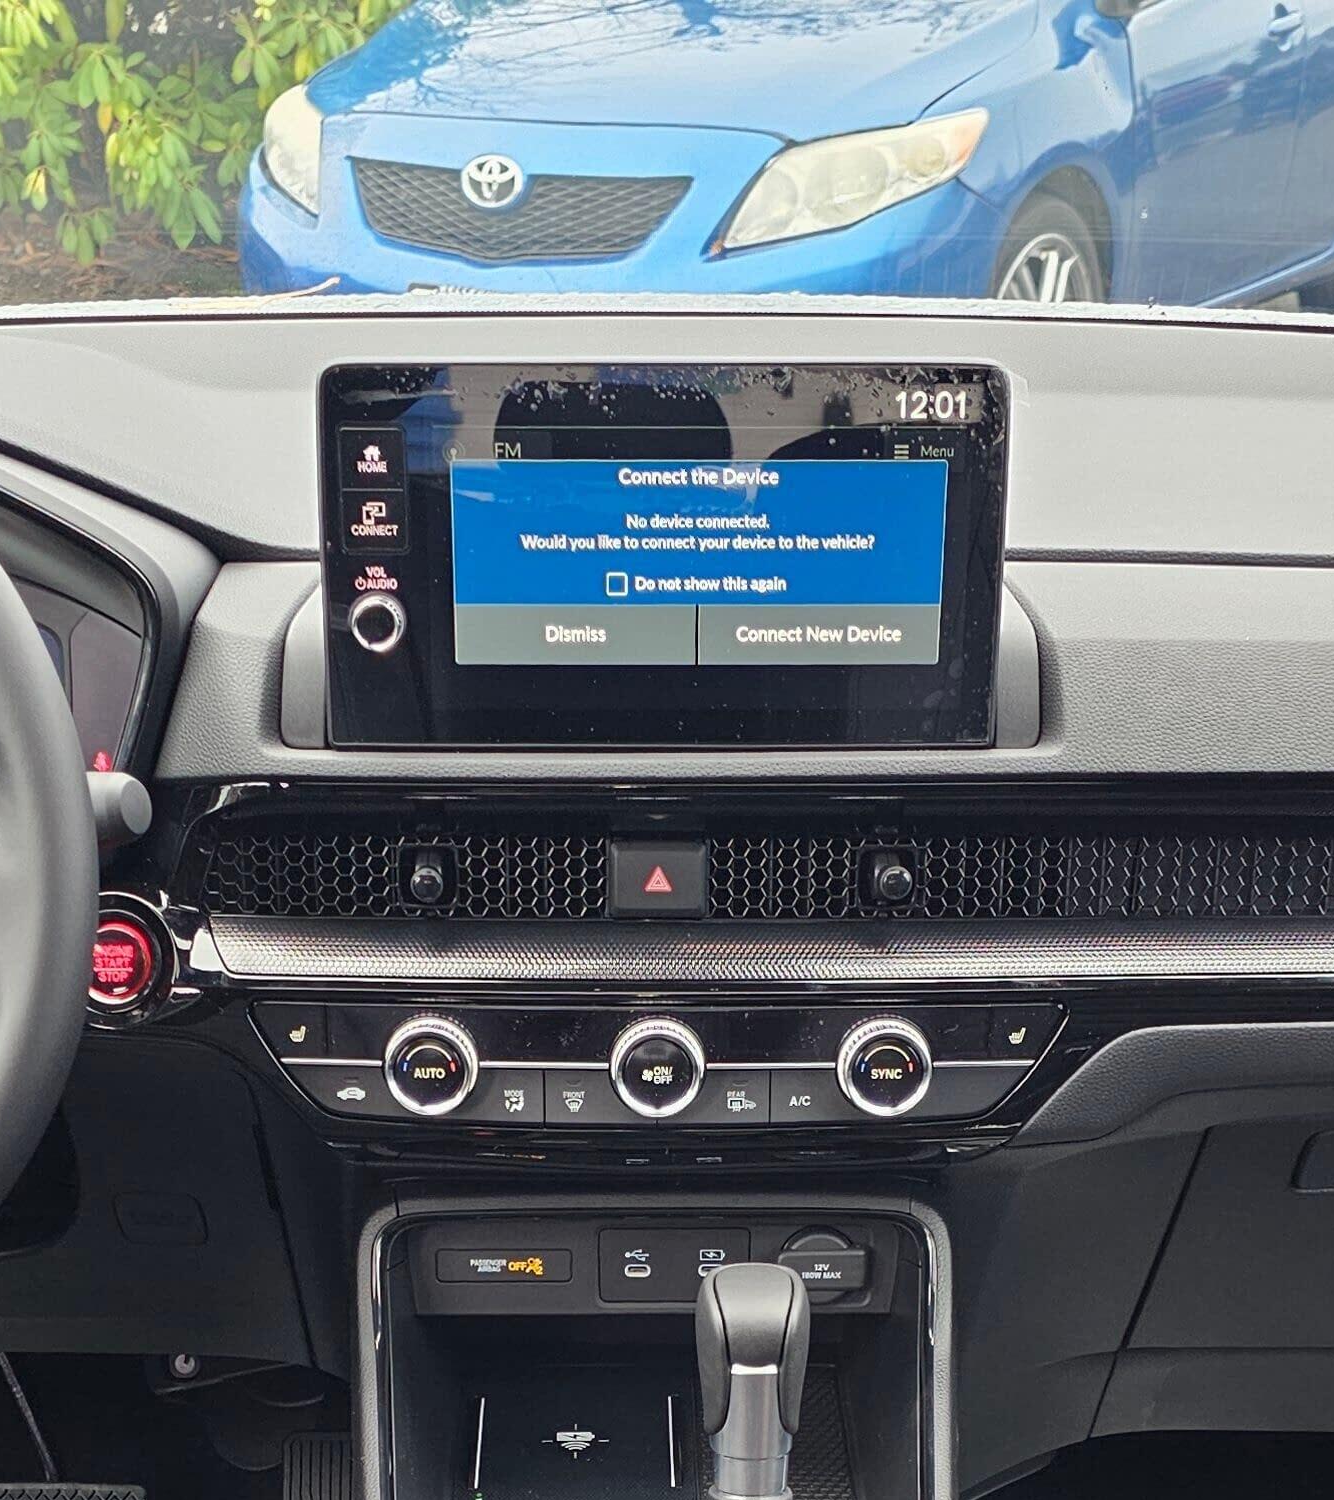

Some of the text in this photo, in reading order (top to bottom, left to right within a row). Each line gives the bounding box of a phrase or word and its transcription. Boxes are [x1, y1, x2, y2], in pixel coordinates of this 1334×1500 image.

[895, 390, 967, 420] 12:01
[494, 443, 522, 459] FM
[920, 445, 955, 458] Menu
[357, 461, 387, 473] HOME
[619, 467, 779, 486] Connect the Device
[627, 514, 770, 530] No device connected.
[350, 525, 399, 537] CONNECT
[520, 534, 875, 553] Would you like to connect your device to the vehicle?
[365, 566, 387, 578] VOL
[366, 578, 398, 590] AUDIO
[635, 576, 787, 595] Do not show this again
[545, 625, 607, 643] Dismiss
[735, 625, 902, 643] Connect New Device
[94, 958, 131, 968] START
[97, 971, 129, 982] STOP
[413, 1067, 445, 1080] AUTO
[870, 1069, 902, 1080] SYNC
[504, 1089, 524, 1098] MODE
[563, 1091, 585, 1099] FRONT
[789, 1096, 811, 1107] A/C
[508, 1261, 527, 1271] OFF
[813, 1263, 830, 1271] 12V
